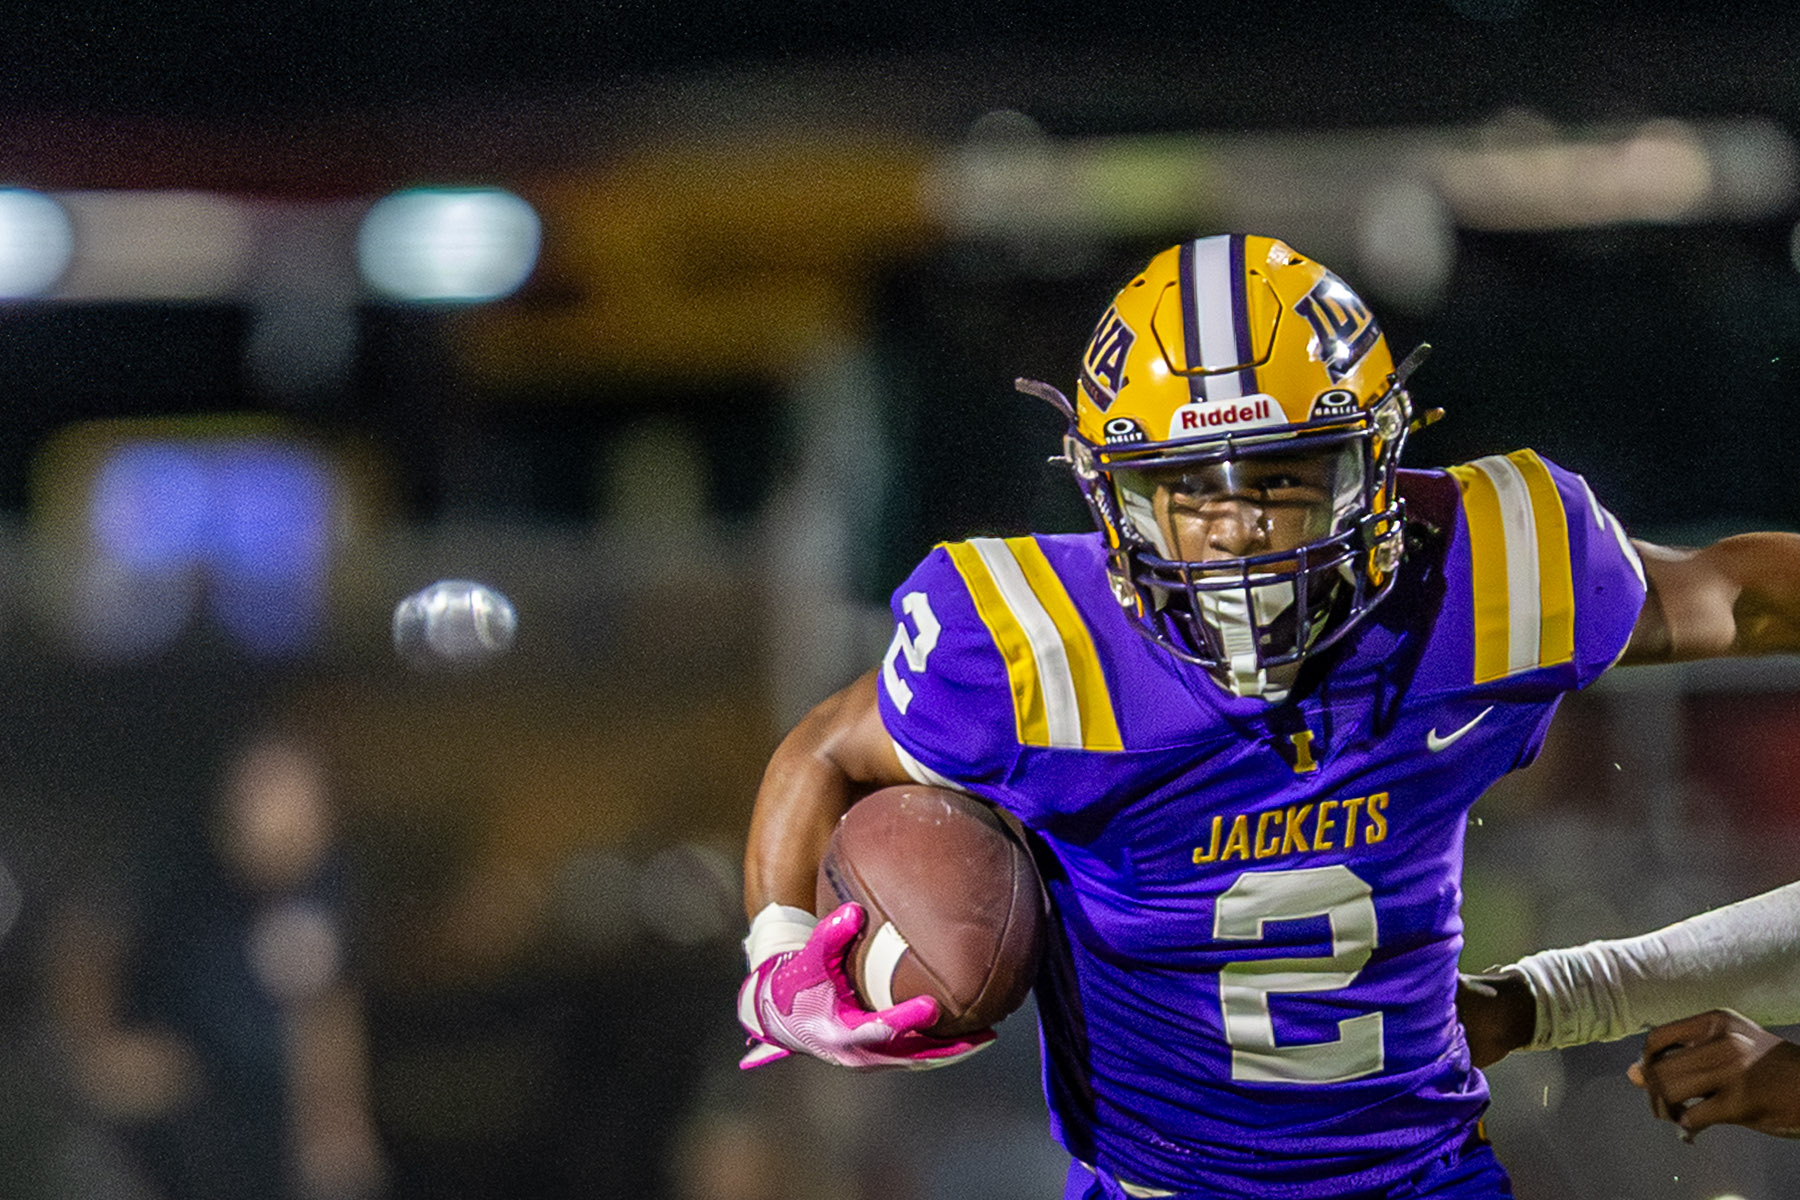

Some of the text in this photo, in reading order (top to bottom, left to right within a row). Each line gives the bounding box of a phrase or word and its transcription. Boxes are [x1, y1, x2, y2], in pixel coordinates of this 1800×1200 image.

[1181, 400, 1271, 430] Riddell
[882, 591, 943, 716] 2
[1192, 791, 1390, 865] JACKETS
[1212, 864, 1386, 1084] 2
